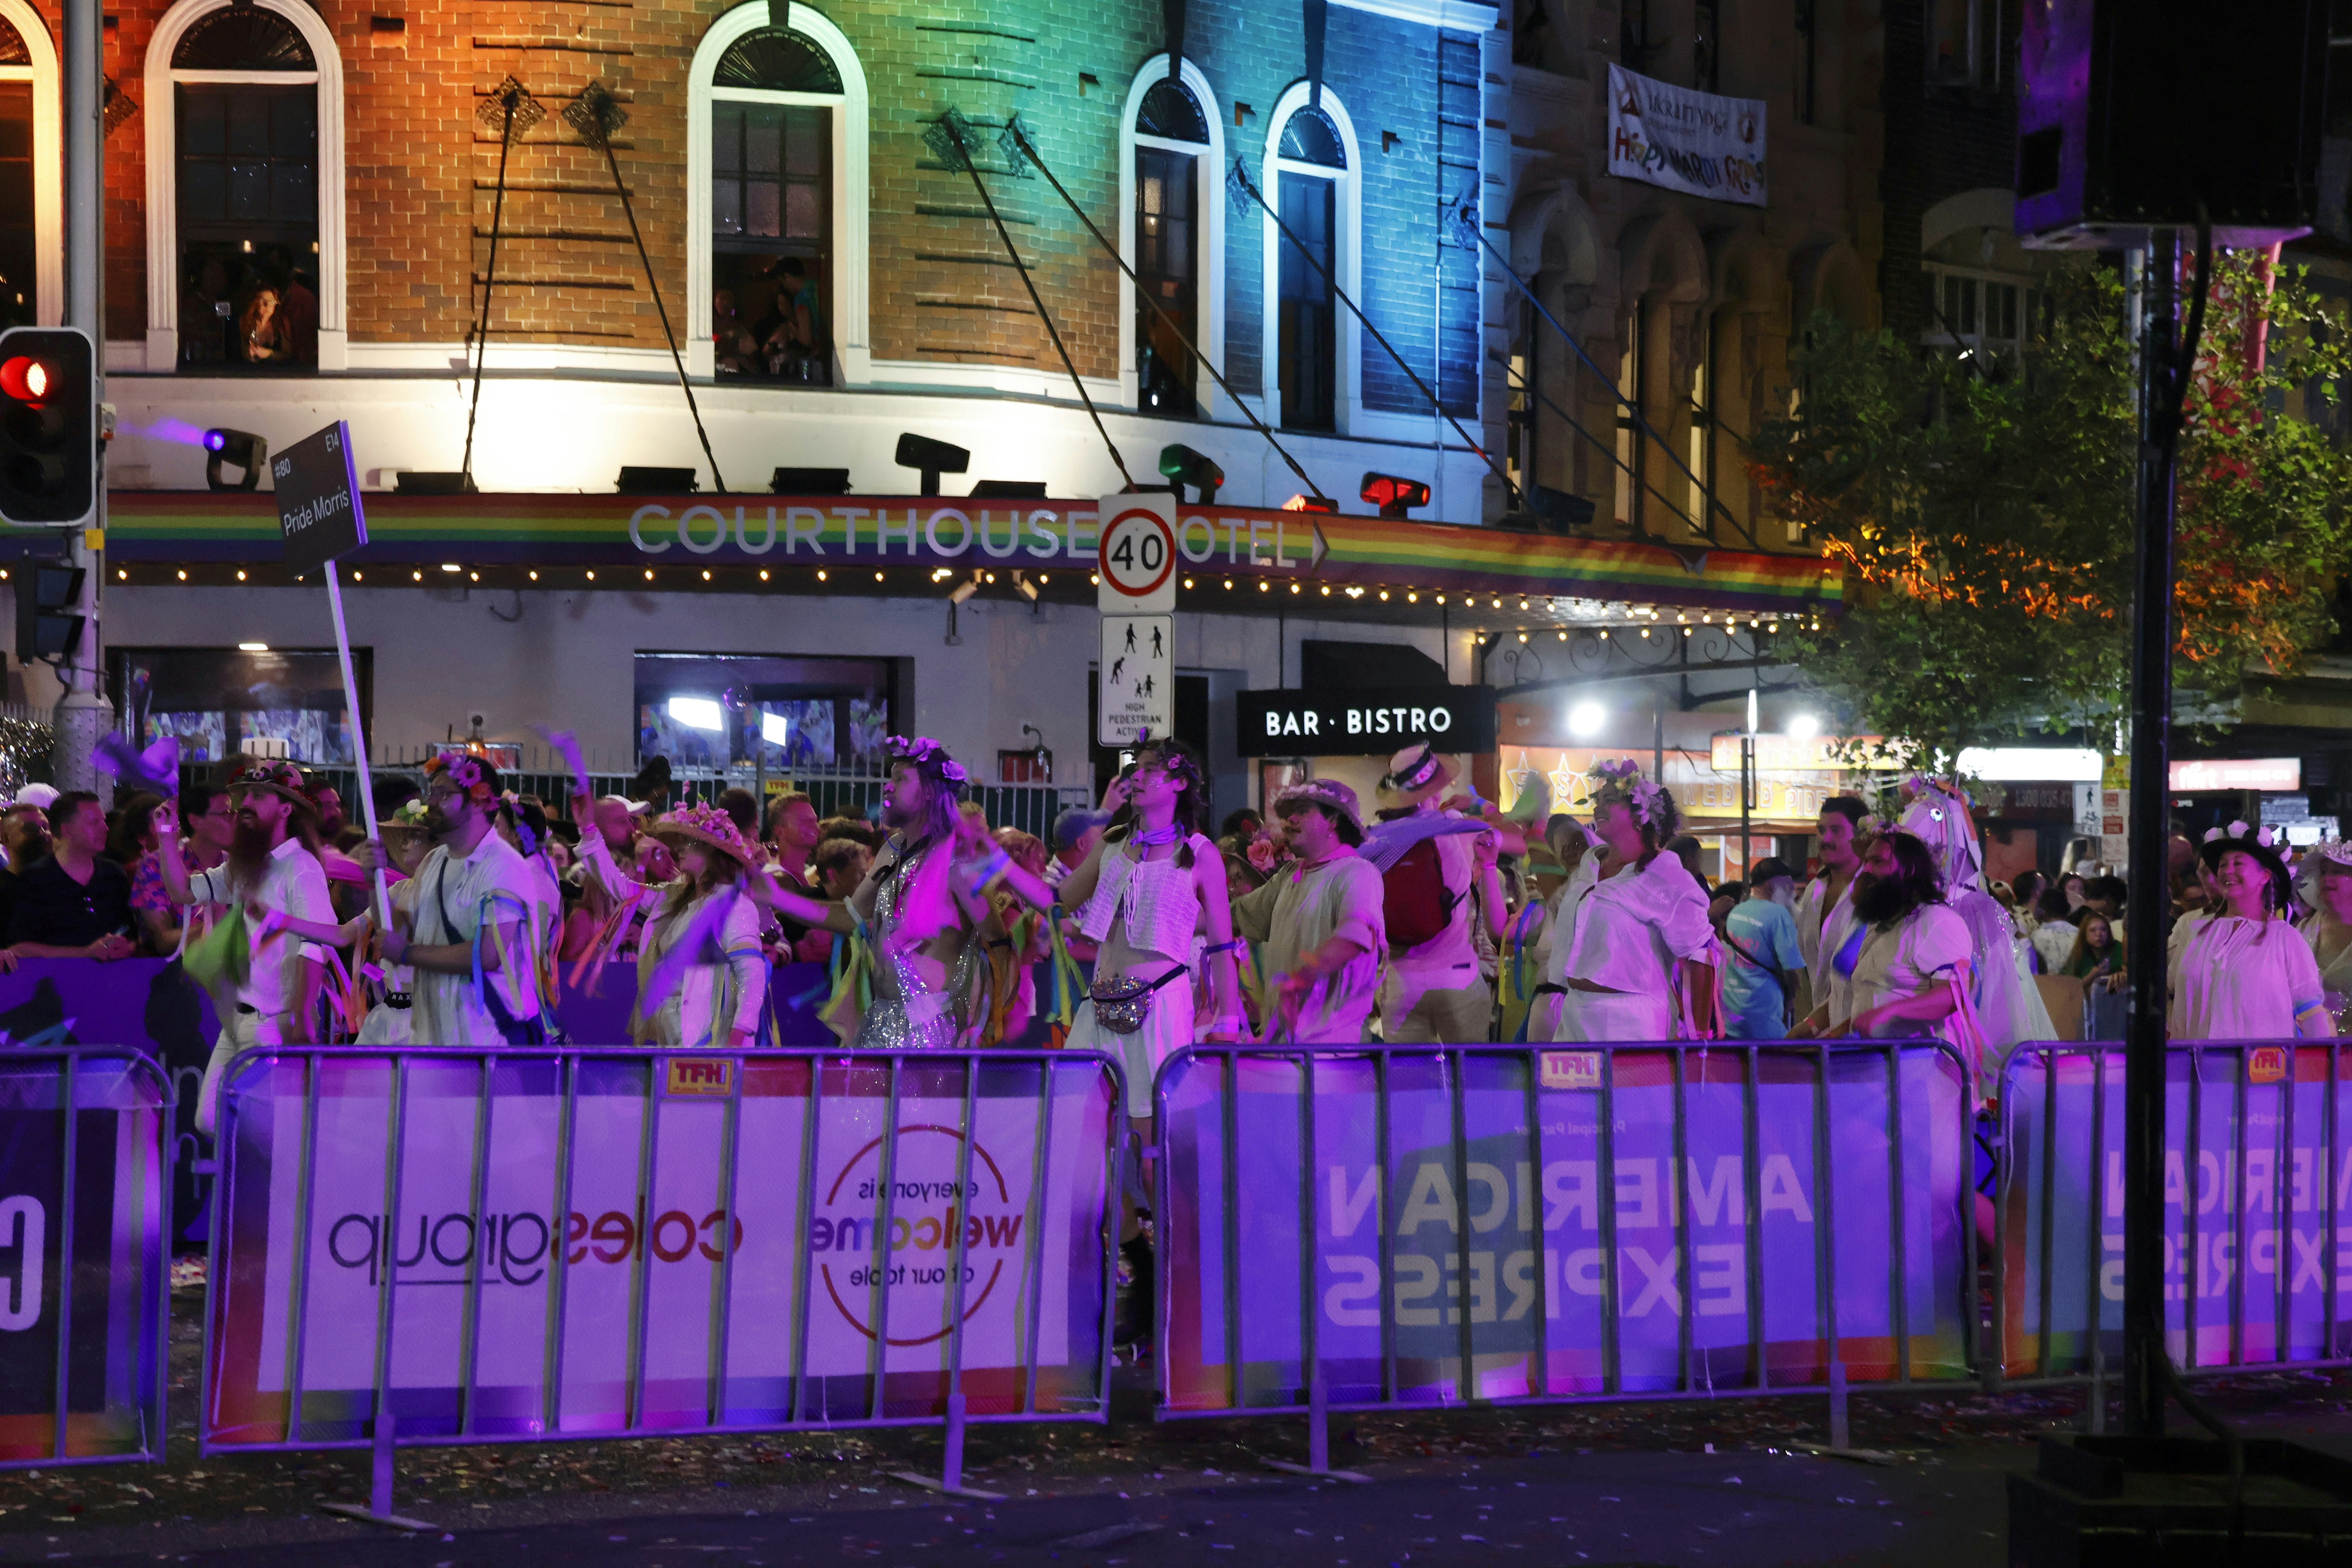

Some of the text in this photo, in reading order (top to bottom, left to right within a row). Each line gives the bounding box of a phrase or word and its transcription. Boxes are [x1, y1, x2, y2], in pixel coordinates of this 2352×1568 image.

[325, 432, 339, 452] E14
[274, 457, 291, 479] #80
[283, 486, 349, 536] Pride Morris
[629, 505, 1296, 568] COURTHOUSE OTEL
[1111, 534, 1163, 571] 40
[1125, 702, 1145, 712] HIGH
[1109, 715, 1161, 724] PEDESTRIAN
[1266, 707, 1451, 737] BAR BISTRO
[1116, 726, 1154, 736] ACTIVY
